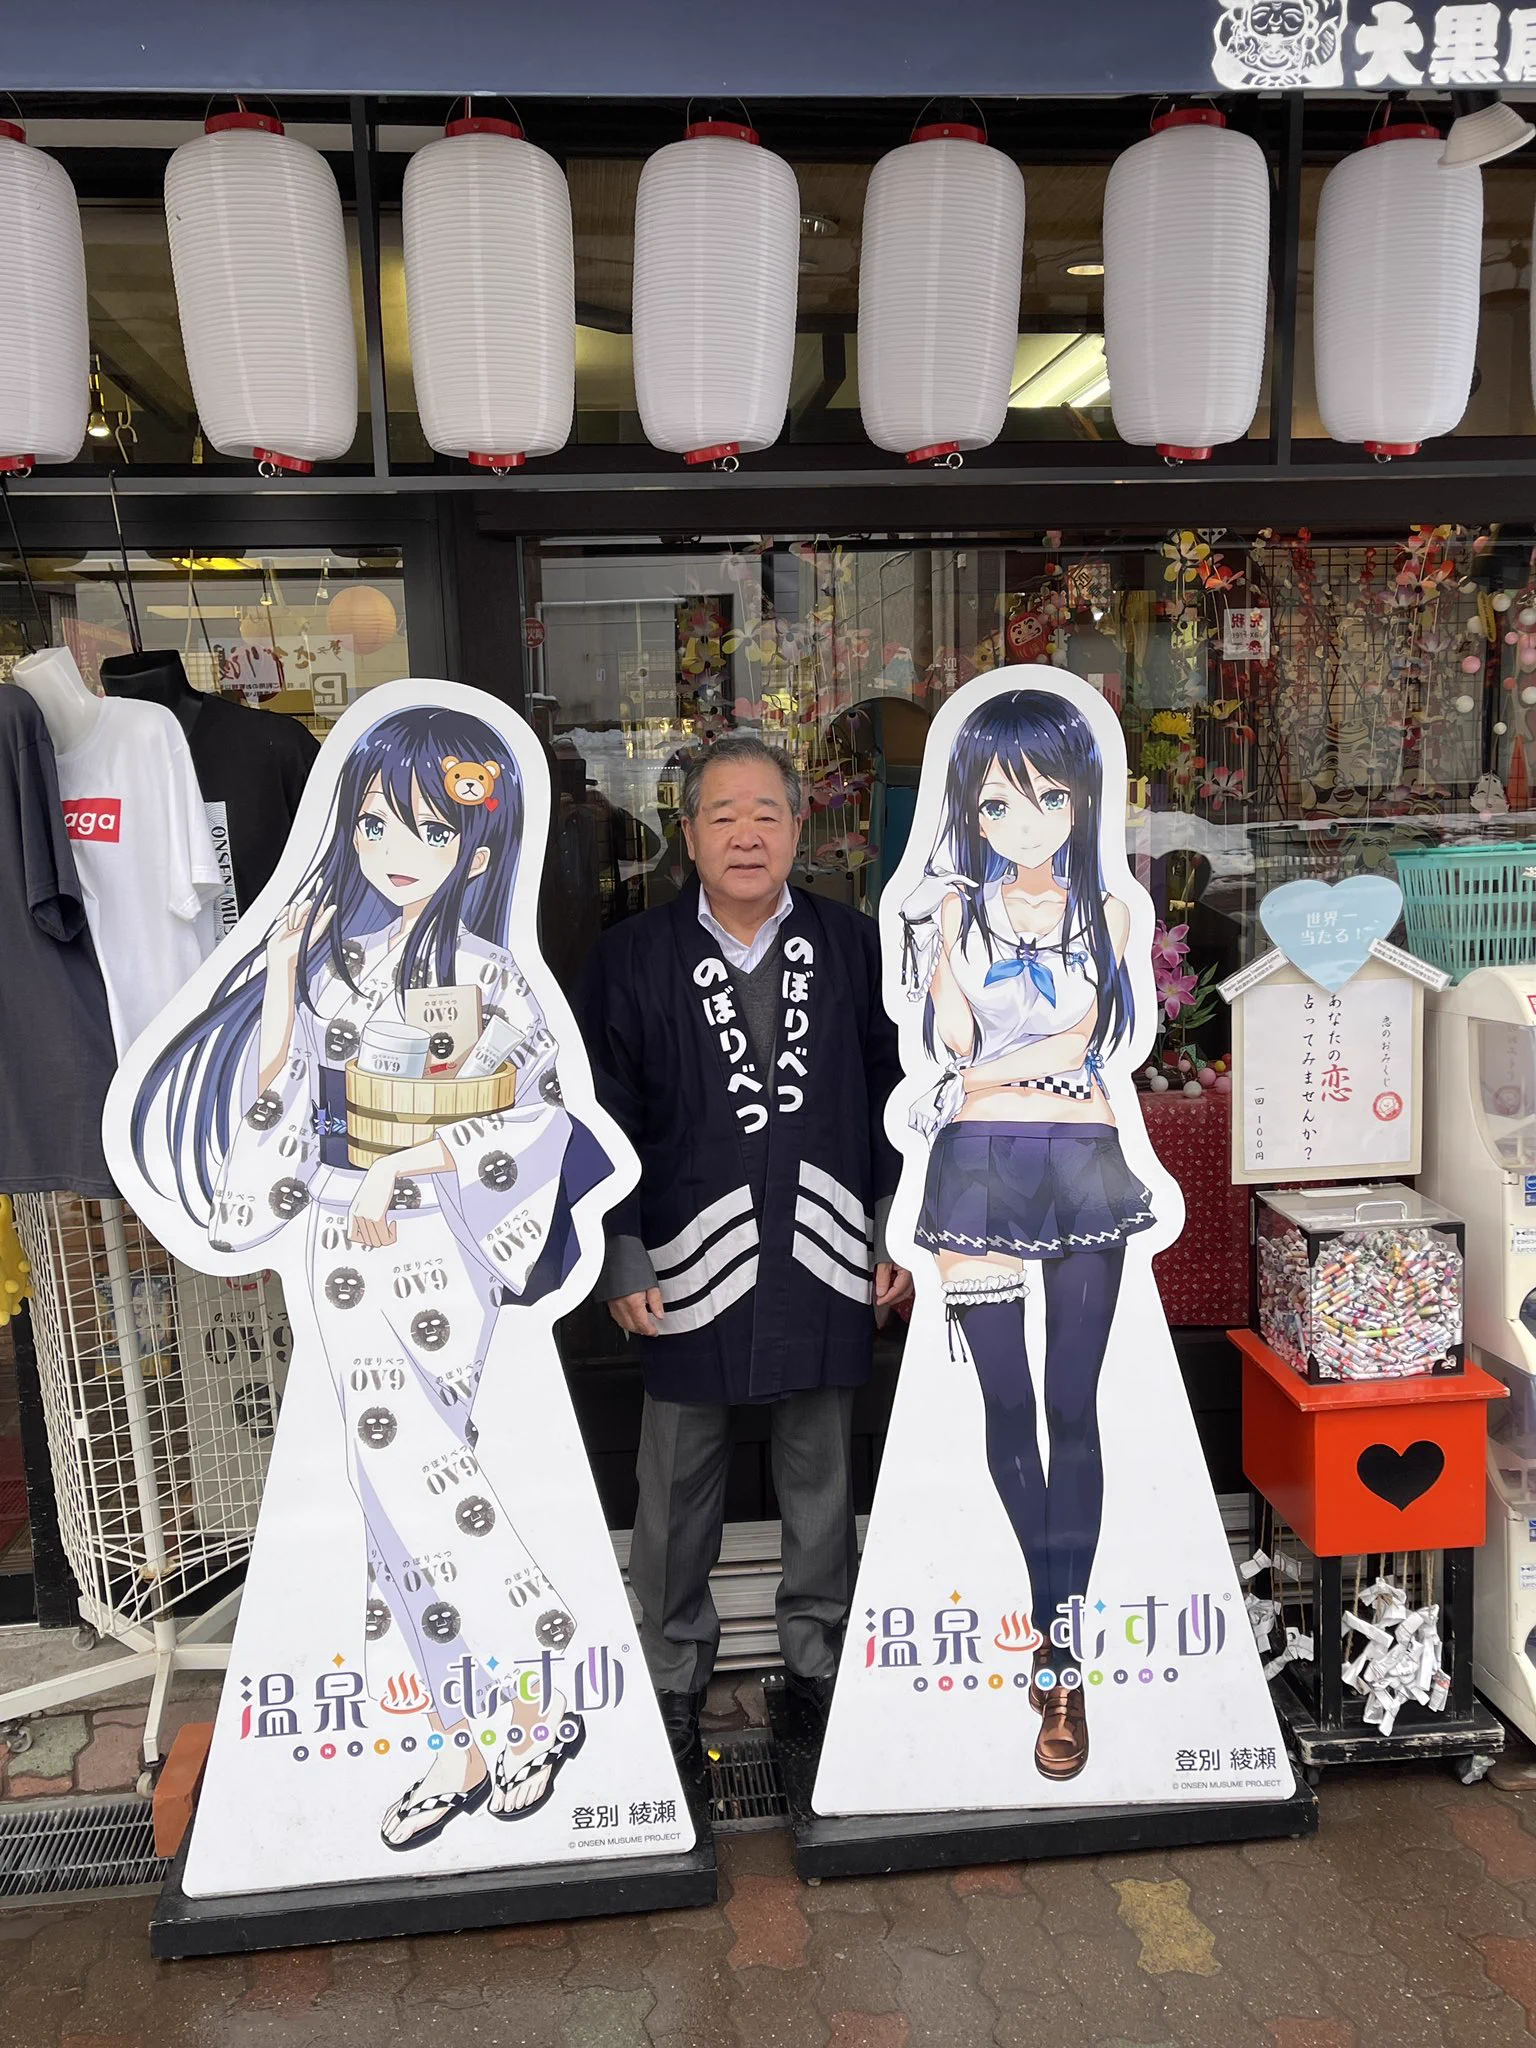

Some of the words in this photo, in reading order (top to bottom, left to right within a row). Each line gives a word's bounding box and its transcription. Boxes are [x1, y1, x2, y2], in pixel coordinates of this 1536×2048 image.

[1306, 911, 1359, 928] 世界一
[777, 936, 815, 1113] のぼりべつ
[693, 956, 770, 1135] のぼりべつ
[1320, 994, 1353, 1103] あなたの恋
[1380, 1015, 1393, 1088] 恋のおみくじ
[1301, 994, 1317, 1161] 占ってみませんか？
[278, 1135, 322, 1167] OV
[486, 1209, 531, 1242] のぼりべつ
[392, 1257, 444, 1274] のぼりべつ
[352, 1357, 406, 1367] のぼりべつ
[402, 1550, 453, 1569] のぼりべつ
[865, 1589, 985, 1669] 温泉
[239, 1652, 369, 1740] 温泉
[1175, 1748, 1221, 1772] 登別
[1229, 1747, 1277, 1771] 綾瀬
[1210, 1780, 1244, 1789] MUSUME
[1245, 1779, 1282, 1787] PROJECT
[571, 1804, 619, 1830] 登別
[628, 1799, 677, 1826] 綾瀬
[577, 1839, 606, 1848] ONSEN
[607, 1835, 643, 1845] MUSUME
[644, 1832, 681, 1842] PROJECT
